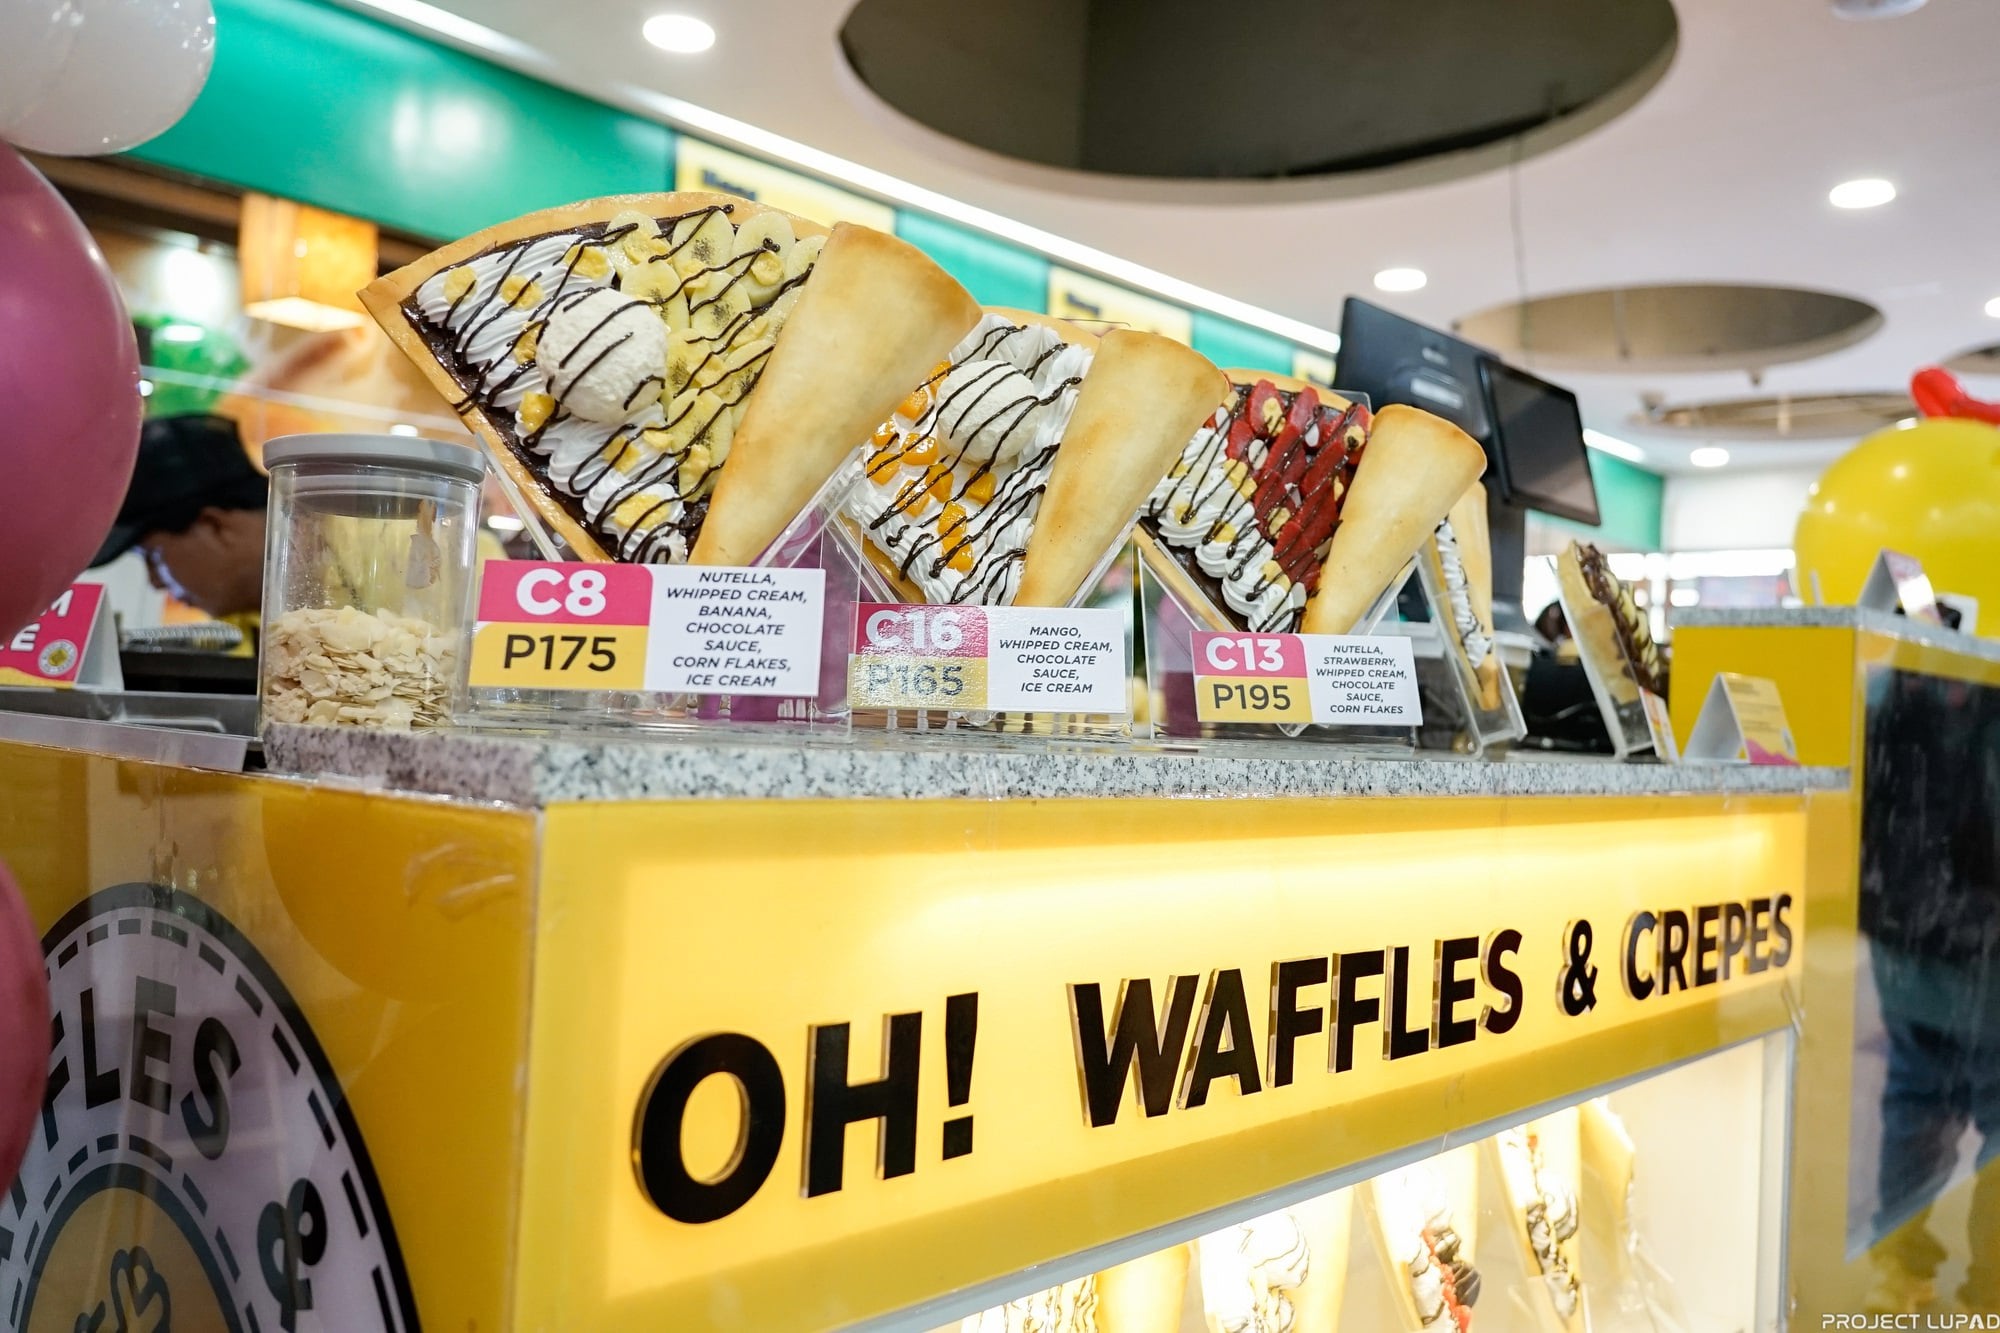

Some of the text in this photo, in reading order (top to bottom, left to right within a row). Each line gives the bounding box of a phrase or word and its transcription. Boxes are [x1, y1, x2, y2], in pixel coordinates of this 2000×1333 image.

[698, 571, 776, 586] NUTELLA,
[516, 568, 607, 617] C8
[667, 587, 807, 604] WHIPPED CREAM,
[698, 605, 772, 620] BANANA,
[685, 622, 785, 636] CHOCOLATE
[865, 609, 963, 651] C16
[1029, 626, 1082, 639] MANGO,
[503, 634, 617, 672] P175
[703, 639, 762, 654] SAUCE,
[999, 639, 1113, 653] WHIPPED CREAM,
[1333, 645, 1384, 656] NUTELLA,
[1016, 654, 1097, 665] CHOCOLATE
[1205, 636, 1285, 672] C13
[672, 656, 791, 672] CORN FLAKES,
[1323, 656, 1396, 668] STRAWBERRY,
[685, 674, 777, 687] ICE CREAM
[867, 663, 964, 697] P165
[1032, 668, 1080, 681] SAUCE,
[1316, 668, 1408, 680] WHIPPED CREAM,
[1020, 682, 1093, 694] ICE CREAM
[1331, 680, 1396, 691] CHOCOLATE
[1212, 683, 1292, 711] P195
[1346, 692, 1384, 703] SAUCE,
[1330, 704, 1404, 715] CORN FLAKES
[632, 892, 1794, 1225] OH! WAFFLES & CREPES
